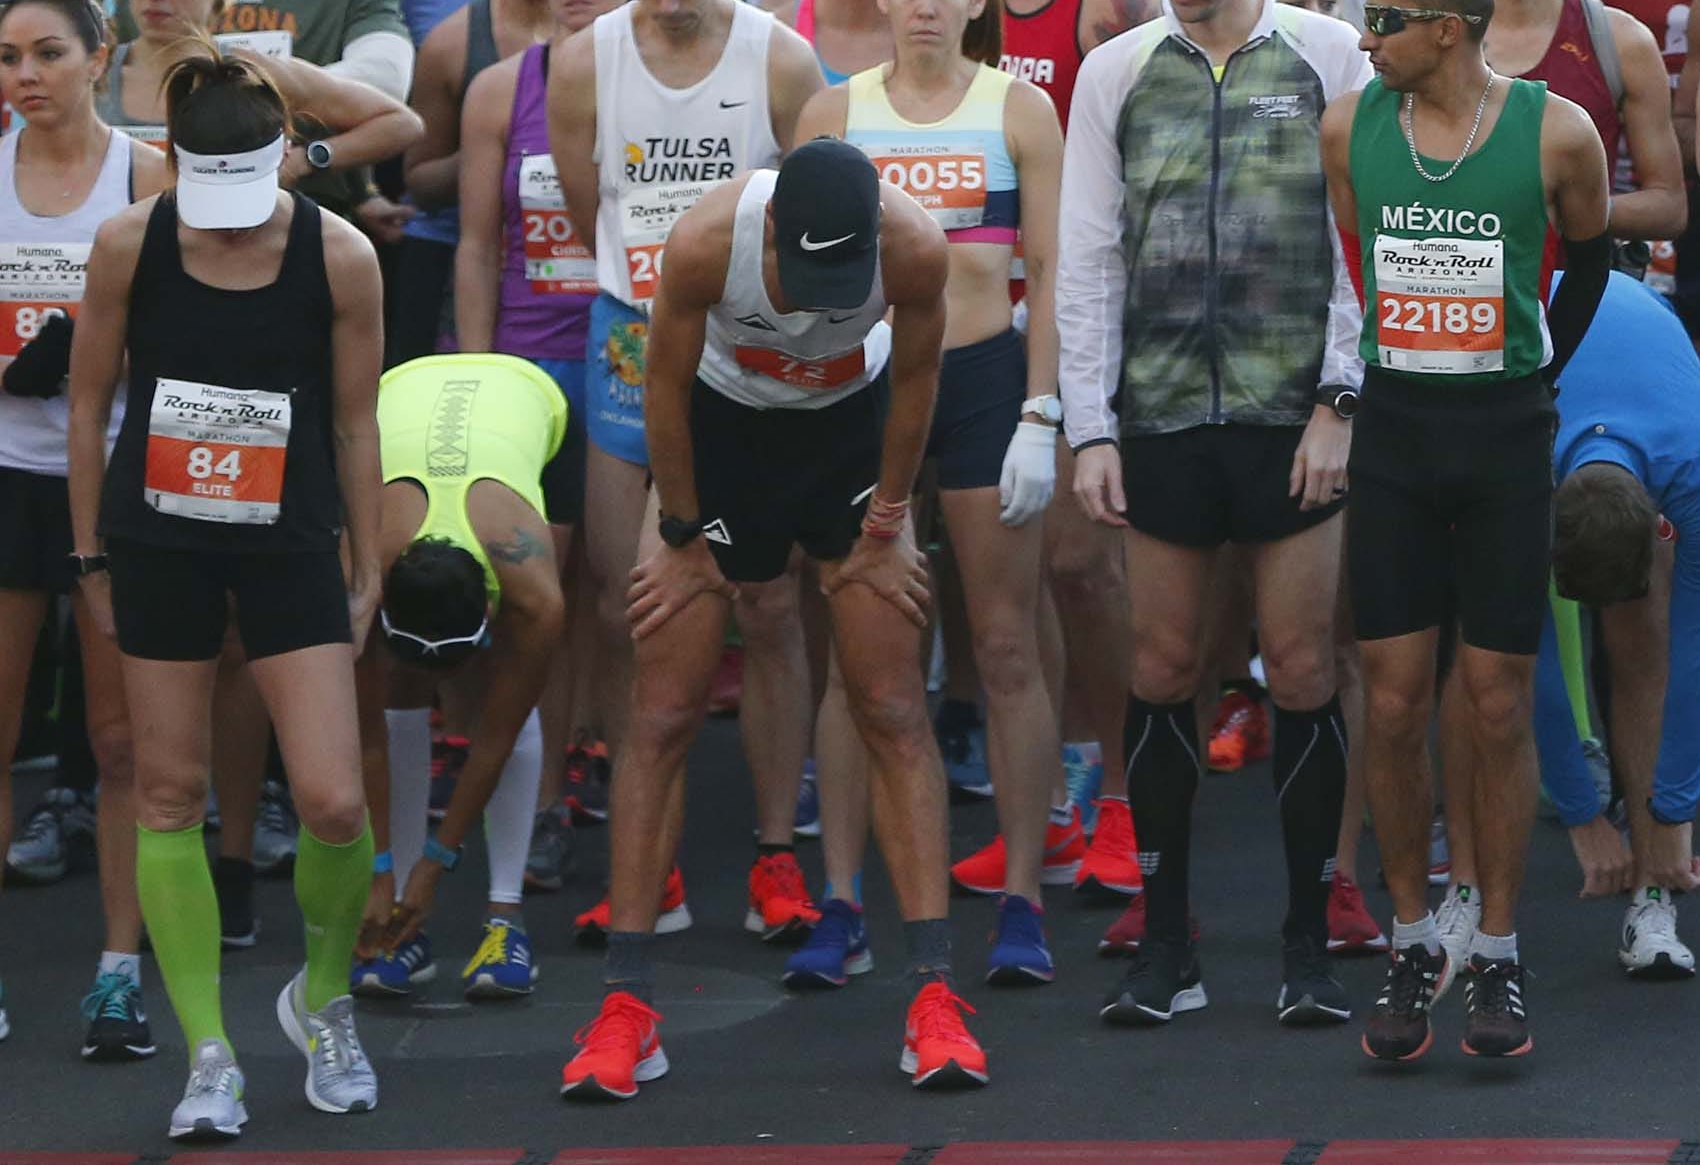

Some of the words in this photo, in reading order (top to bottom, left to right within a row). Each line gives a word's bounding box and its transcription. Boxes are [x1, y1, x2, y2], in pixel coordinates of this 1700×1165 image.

[646, 137, 731, 159] TULSA
[890, 146, 949, 154] MARATHON
[625, 162, 735, 183] RUNNER
[879, 161, 983, 191] 0055
[658, 187, 702, 200] Humana
[1381, 202, 1501, 238] MÉXICO
[17, 246, 63, 256] Humana
[1413, 243, 1459, 253] Humana
[0, 261, 34, 272] ock
[1397, 267, 1478, 276] ARIZONA
[1407, 286, 1466, 295] MARATHON
[1382, 298, 1497, 334] 22189
[200, 387, 249, 402] Humana
[177, 412, 263, 426] ARIZONA
[187, 430, 251, 443] MARATHON
[187, 447, 242, 481] 84
[192, 483, 233, 496] ELITE
